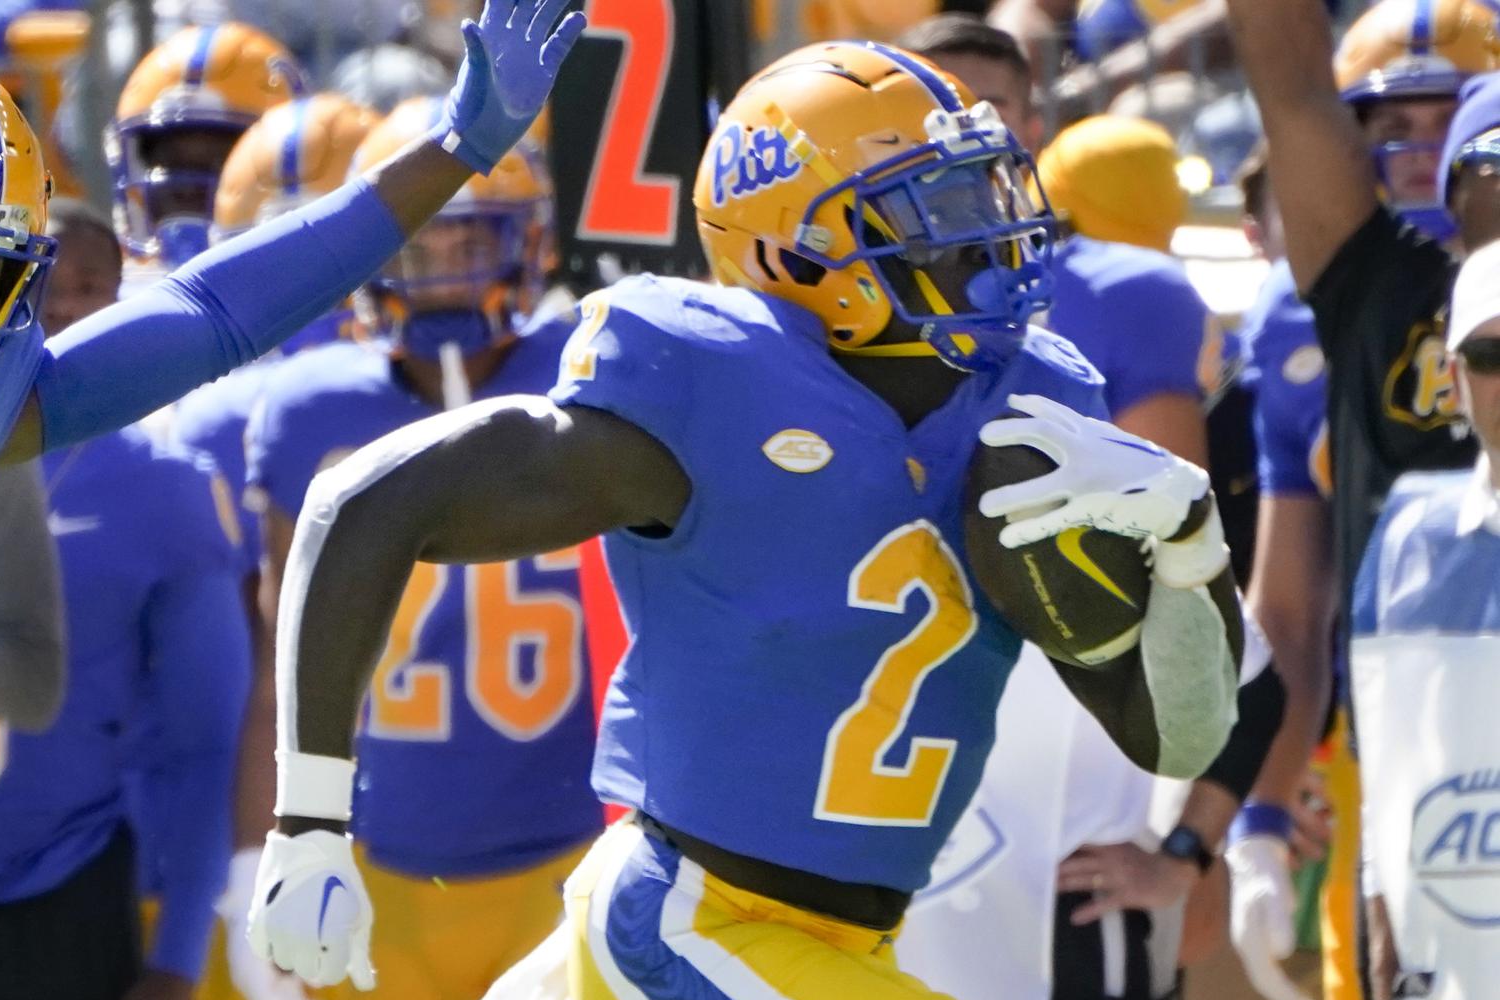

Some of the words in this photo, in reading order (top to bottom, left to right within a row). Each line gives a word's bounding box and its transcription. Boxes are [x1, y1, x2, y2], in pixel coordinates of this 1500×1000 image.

[575, 0, 680, 246] 2
[711, 122, 801, 206] Pitt
[770, 440, 822, 460] ACC
[365, 544, 584, 742] 26
[812, 518, 979, 828] 2
